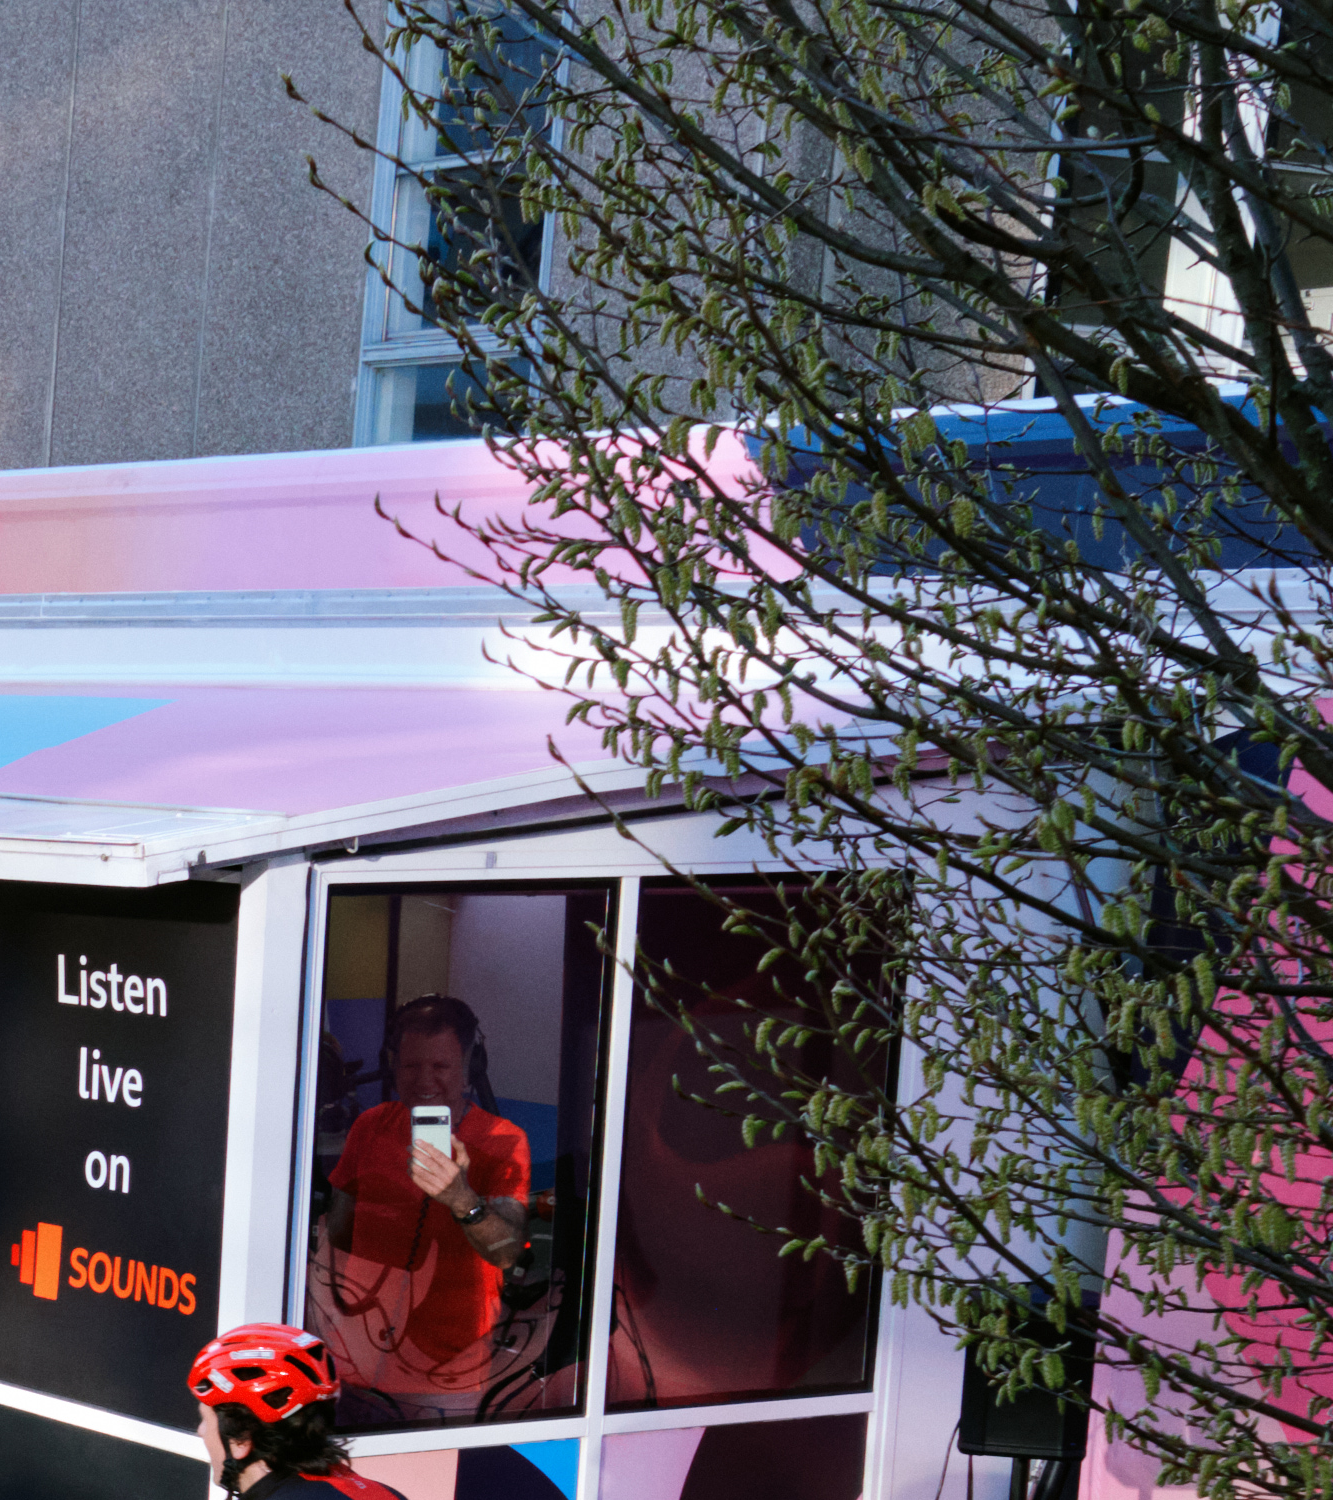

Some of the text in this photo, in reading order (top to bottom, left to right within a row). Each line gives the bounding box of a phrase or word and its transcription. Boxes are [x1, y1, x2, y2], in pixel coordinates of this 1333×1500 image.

[57, 953, 168, 1018] Listen
[78, 1046, 144, 1108] live
[84, 1149, 131, 1194] on
[68, 1247, 198, 1316] SOUNDS
